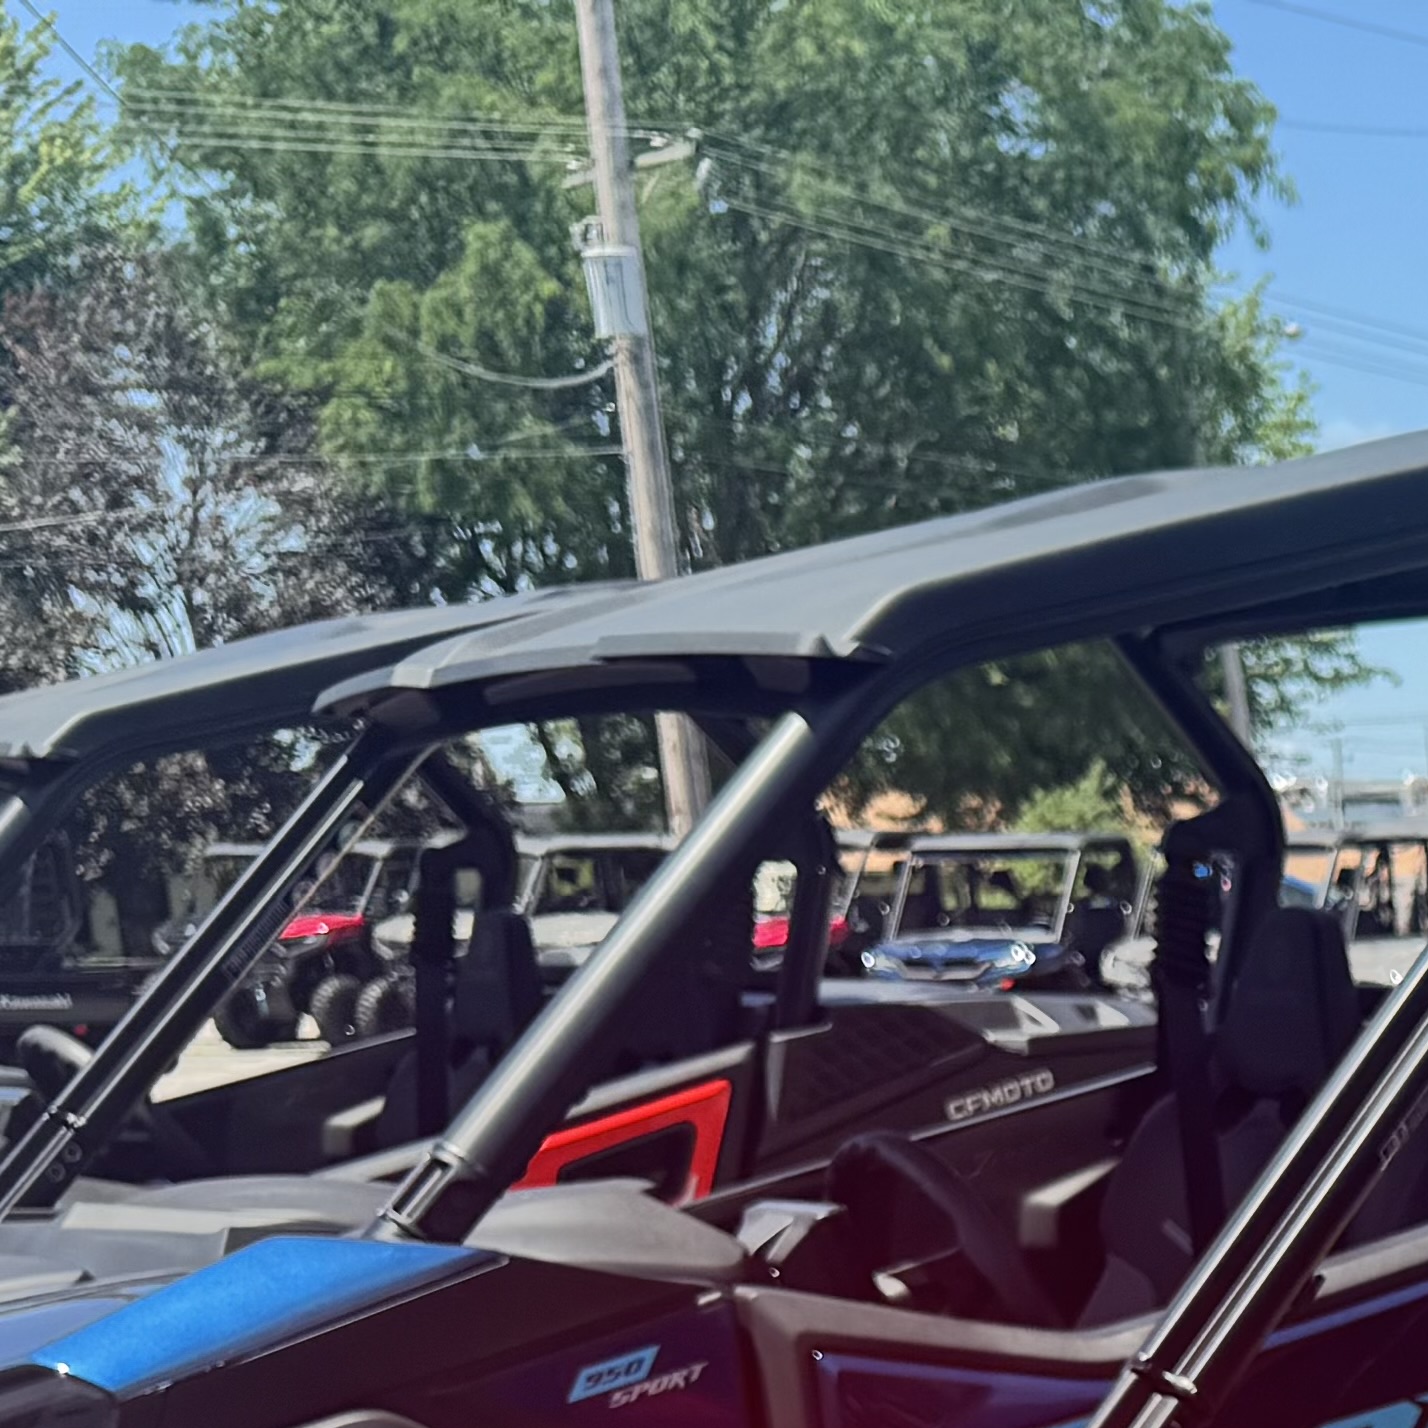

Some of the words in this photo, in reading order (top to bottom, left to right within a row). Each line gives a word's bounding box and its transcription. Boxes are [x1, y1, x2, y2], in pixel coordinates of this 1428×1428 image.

[945, 1067, 1056, 1121] CFMOTO
[584, 1356, 643, 1389] 950
[608, 1361, 709, 1409] SPORT
